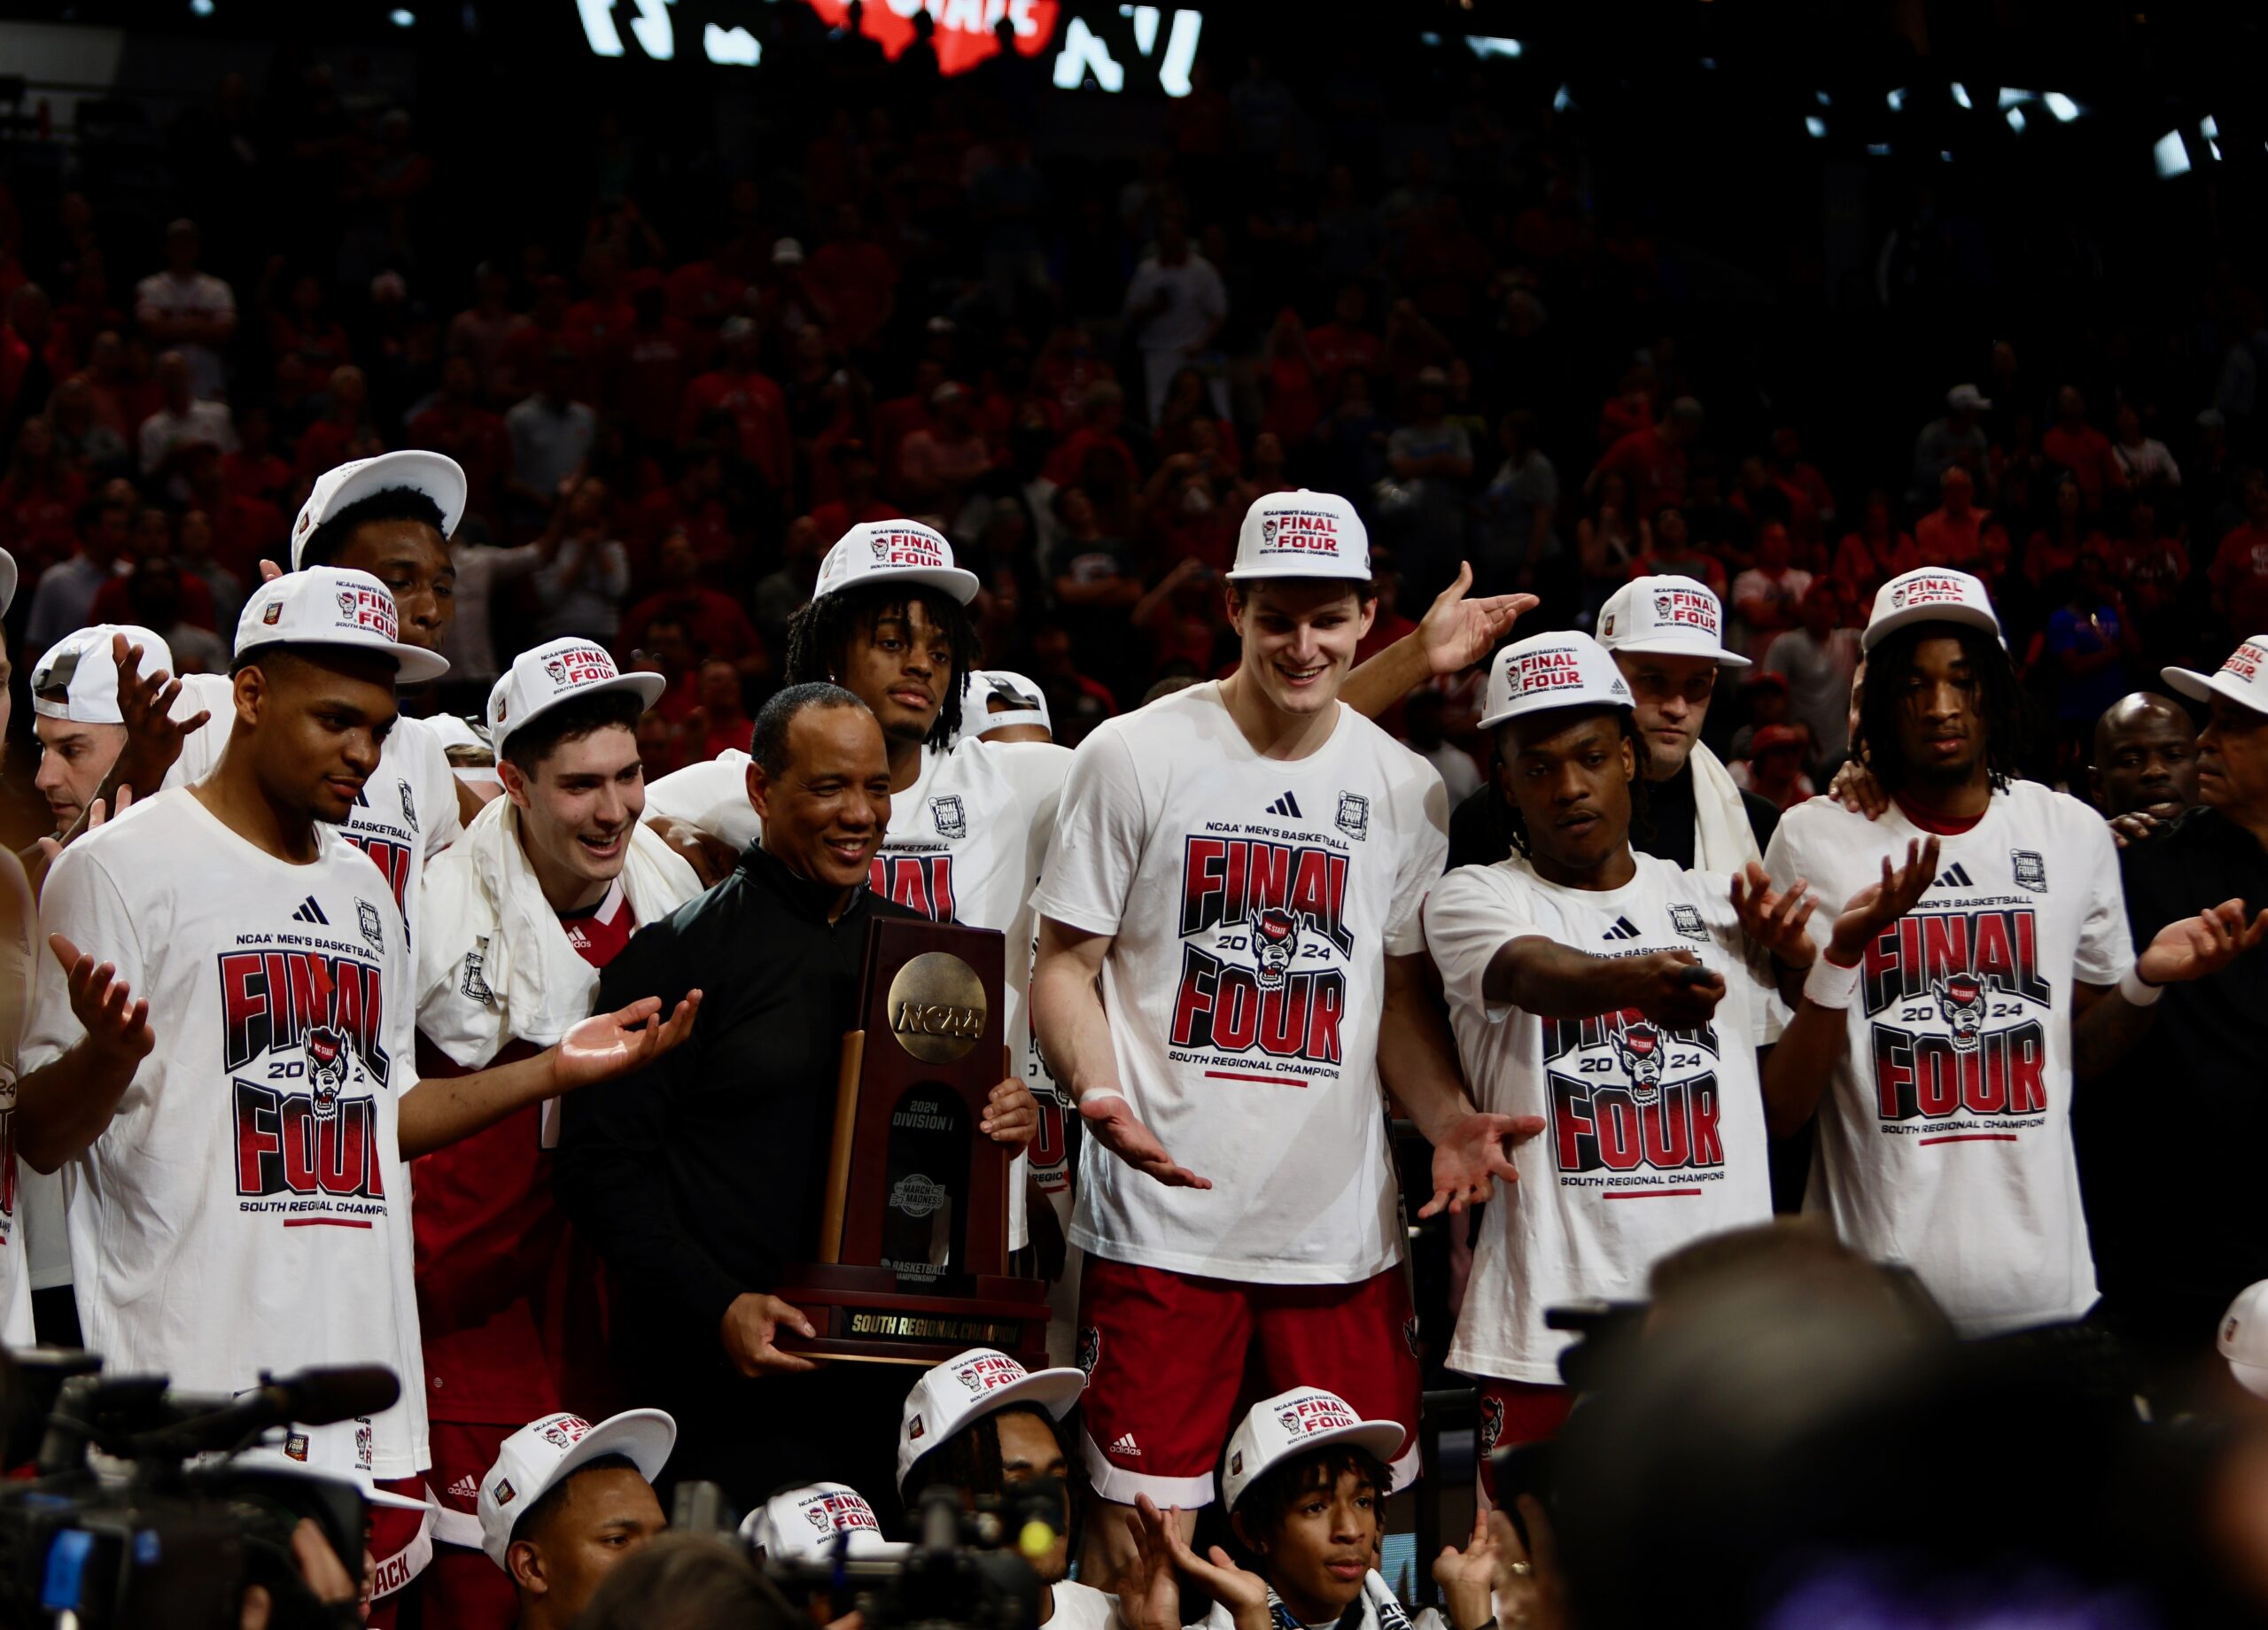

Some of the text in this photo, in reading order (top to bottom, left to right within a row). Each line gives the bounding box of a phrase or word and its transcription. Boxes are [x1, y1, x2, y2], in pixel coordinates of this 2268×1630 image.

[1300, 510, 1340, 519] BASKETBALL
[1280, 516, 1338, 532] FINAL
[891, 535, 942, 555] FINAL
[1278, 535, 1338, 552] FOUR
[1908, 579, 1963, 594] FINAL
[359, 591, 397, 624] FINAL
[1674, 594, 1716, 614] FINAL
[1674, 610, 1716, 632] FOUR
[540, 650, 558, 661] NCAA
[563, 651, 611, 666] FINAL
[2239, 645, 2264, 663] NAL
[1521, 653, 1578, 672] FINAL
[1523, 671, 1581, 690] FOUR
[936, 803, 958, 814] FINAL
[1341, 800, 1363, 812] FINAL
[938, 812, 959, 825] FOUR
[1340, 810, 1362, 822] FOUR
[351, 819, 412, 842] BASKETBALL
[1206, 821, 1349, 850] NCAA MEN'S BASKETBALL
[2016, 857, 2039, 866] FINAL
[2017, 865, 2039, 876] FOUR
[1178, 834, 1354, 962] FINAL
[1916, 896, 2032, 909] MEN'S BASKETBALL
[1674, 909, 1697, 919] FINAL
[1264, 921, 1286, 935] NC STATE
[1676, 917, 1700, 928] FOUR
[236, 934, 380, 962] NCAA MEN'S BASKETBALL
[1216, 935, 1331, 961] 20 24
[1861, 909, 2051, 1020] FINAL
[1960, 990, 1974, 998] STATE
[1169, 941, 1346, 1066] FOUR
[217, 950, 389, 1089] FINAL
[897, 1001, 983, 1039] NCAA
[1901, 1003, 2023, 1021] 20 24
[315, 1042, 334, 1056] NC STATE
[1638, 1039, 1653, 1049] STATE
[1169, 1051, 1340, 1080] SOUTH REGIONAL CHAMPIONS
[1580, 1053, 1701, 1073] 20 24
[1871, 1019, 2047, 1121] FOUR
[268, 1061, 365, 1083] 20 2
[910, 1100, 938, 1114] 2024
[892, 1112, 954, 1131] DIVISION I
[1547, 1068, 1724, 1172] FOUR
[1881, 1124, 1920, 1135] SOUTH
[1921, 1121, 1980, 1133] REGIONAL
[1561, 1170, 1724, 1187] SOUTH REGIONAL CHAMPIONS
[904, 1184, 930, 1195] MARCH
[239, 1201, 286, 1212] SOUTH
[905, 1193, 944, 1206] MADNESS
[891, 1261, 947, 1276] BASKETBALL
[896, 1272, 937, 1283] AMPIONSHIP
[851, 1314, 897, 1333] SOUTH
[897, 1317, 957, 1339] REGIONAL
[951, 1362, 968, 1370] NCAA
[975, 1358, 1022, 1373] FINAL
[1297, 1401, 1349, 1417] FINAL
[1287, 1434, 1308, 1445] SOUTH
[1110, 1445, 1141, 1455] adidas
[823, 1495, 870, 1512] FINAL
[374, 1552, 411, 1595] ACK
